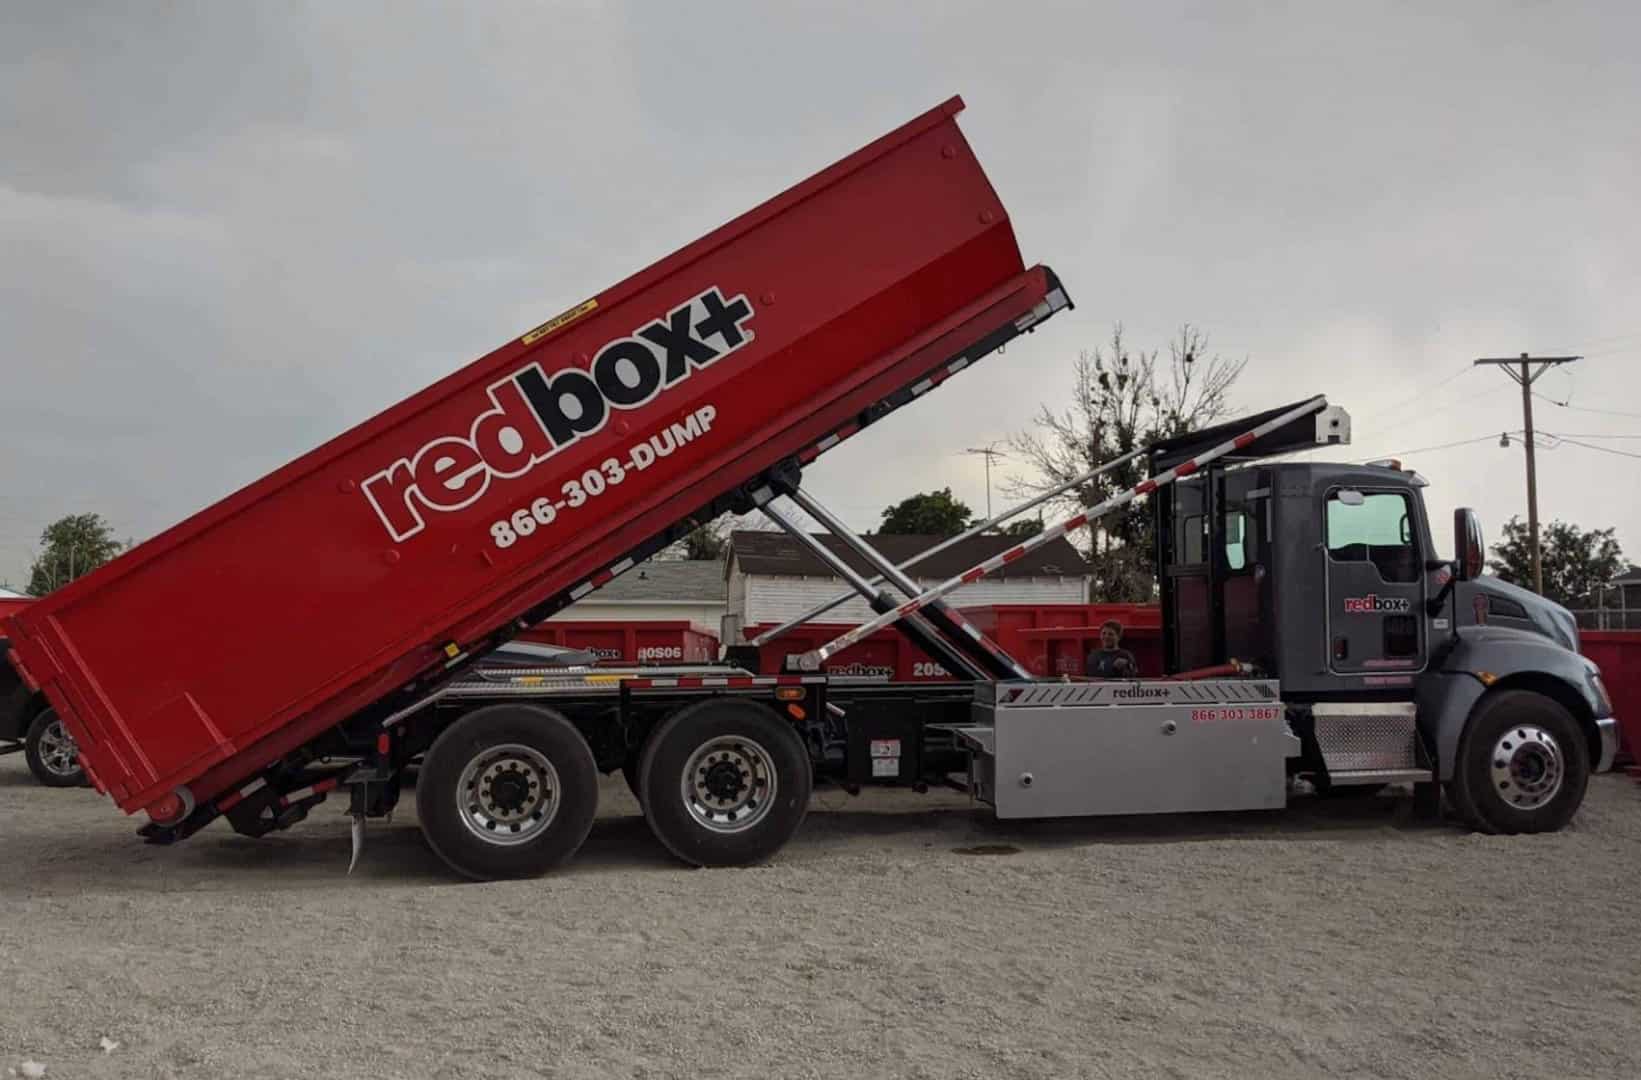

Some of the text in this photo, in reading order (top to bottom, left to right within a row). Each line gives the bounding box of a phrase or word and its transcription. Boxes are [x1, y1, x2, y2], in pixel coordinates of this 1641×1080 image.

[361, 285, 755, 543] redbox+
[490, 404, 717, 549] 866-303-DUMP
[1344, 593, 1410, 613] redbox+
[913, 662, 952, 676] 20S
[1112, 684, 1171, 699] redbox+
[1191, 707, 1281, 721] 866 303 3867
